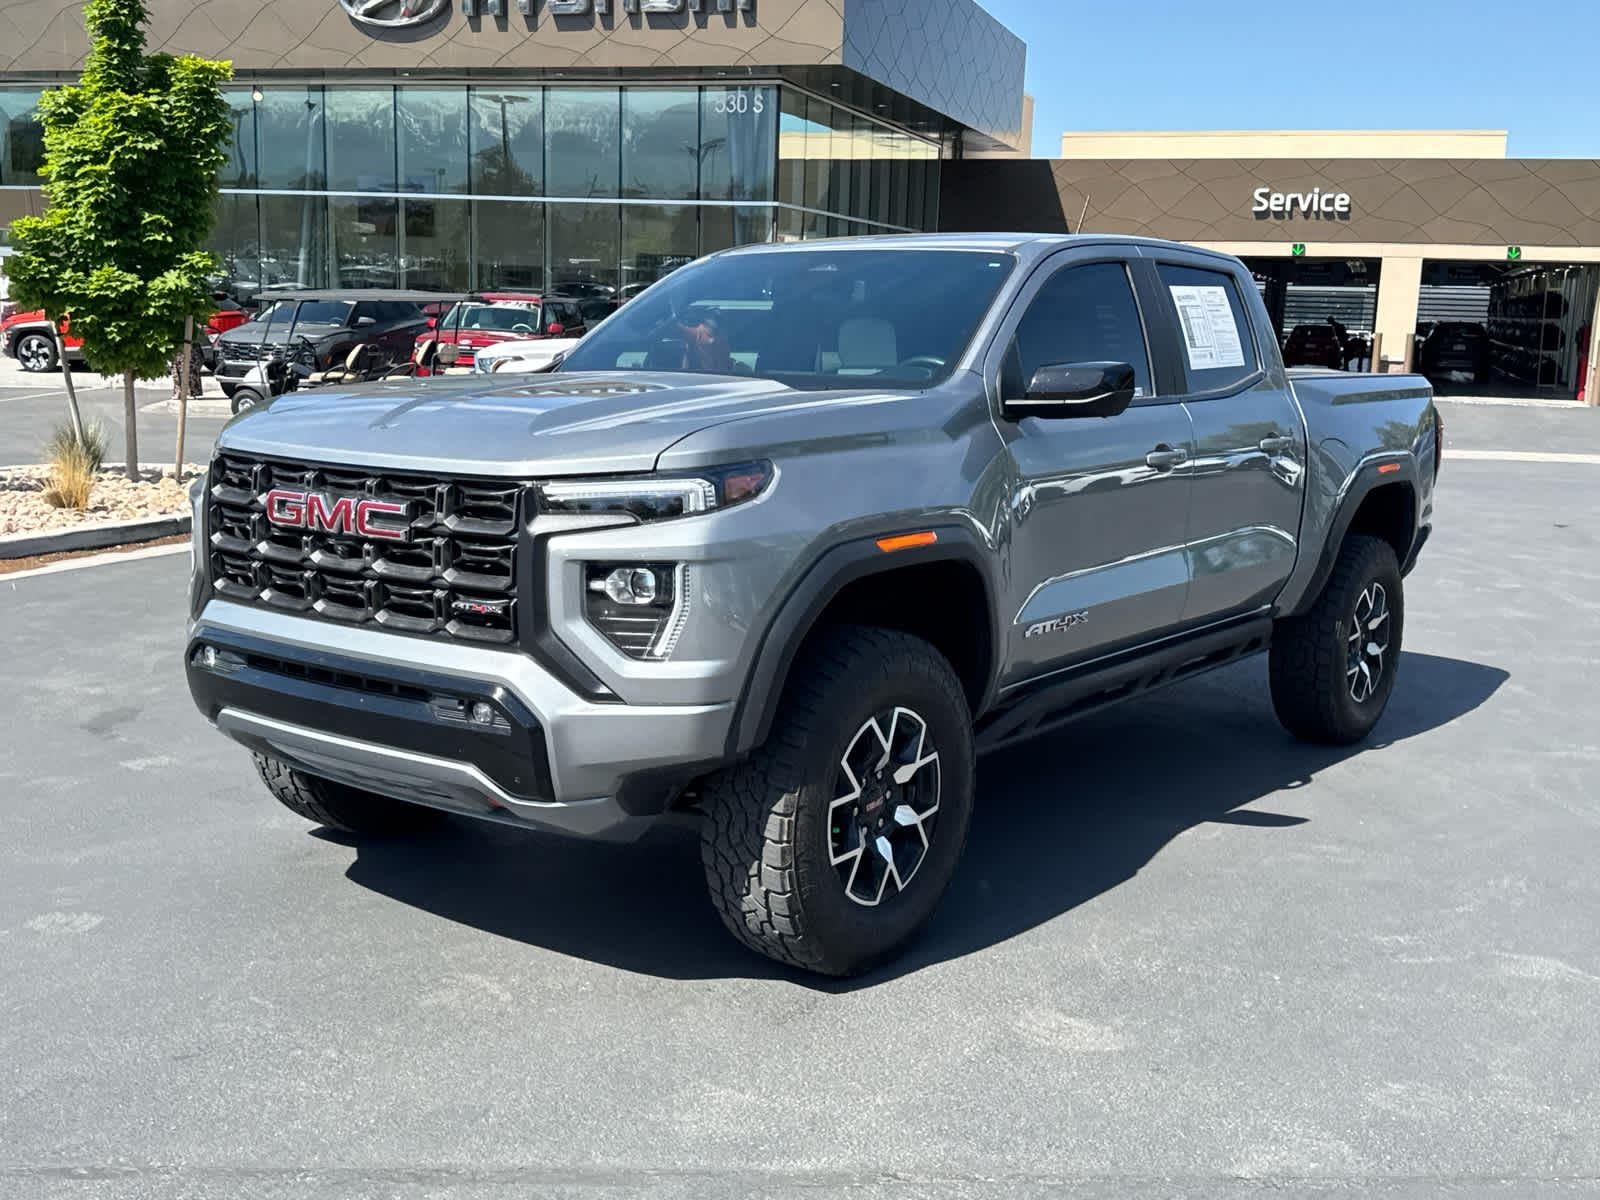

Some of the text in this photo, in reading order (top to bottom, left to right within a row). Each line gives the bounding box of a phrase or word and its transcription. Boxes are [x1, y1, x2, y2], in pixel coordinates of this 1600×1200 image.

[753, 94, 764, 113] S
[1251, 187, 1351, 212] Service
[266, 488, 411, 542] GMC
